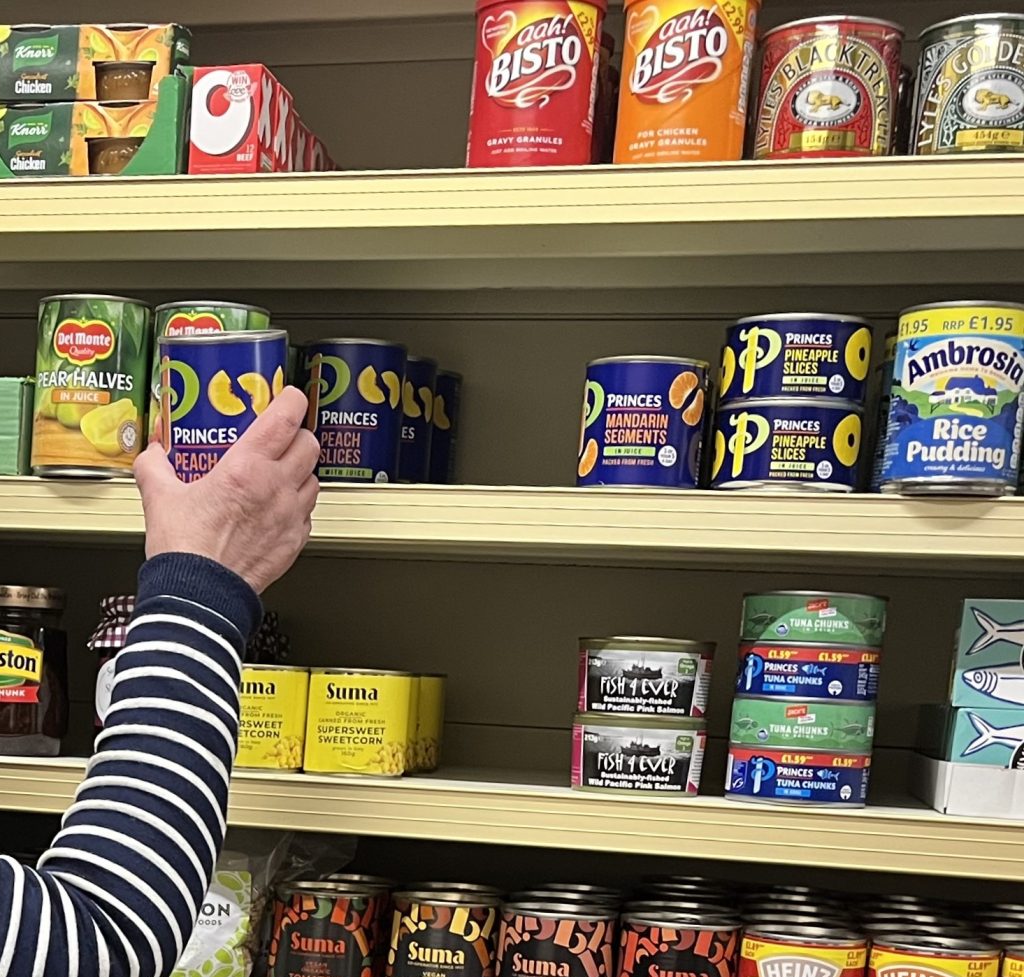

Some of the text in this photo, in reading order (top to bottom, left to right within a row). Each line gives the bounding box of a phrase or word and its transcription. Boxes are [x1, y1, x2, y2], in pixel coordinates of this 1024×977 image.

[517, 14, 574, 46] aah!
[488, 35, 582, 96] BISTO
[15, 80, 52, 94] Chicken
[486, 135, 563, 146] GRAVY GRANULES
[637, 128, 699, 139] FOR CHICKEN
[942, 320, 965, 331] RRP
[969, 316, 1013, 331] £1.95
[58, 332, 111, 347] Del Monte
[784, 348, 838, 363] PINEAPPLE
[908, 340, 1024, 386] Ambrosia
[783, 362, 818, 375] SLICES
[37, 369, 133, 392] PEAR HALVES
[60, 392, 100, 402] IN JUICE
[606, 393, 662, 408] PRINCES
[321, 410, 378, 426] PRINCES
[606, 413, 669, 430] MANDARIN
[173, 427, 238, 444] PRINCES
[933, 417, 987, 441] Rice
[604, 429, 667, 445] SEGMENTS
[175, 452, 218, 471] PEACH
[319, 448, 361, 465] SLICES
[906, 440, 1005, 469] Pudding
[789, 618, 849, 630] TUNA CHUNKS
[629, 677, 637, 695] 4
[641, 677, 679, 698] EVER
[763, 674, 823, 686] TUNA CHUNKS
[591, 703, 685, 714] Wild Pacific Pink Salmon
[317, 725, 386, 735] SUPERSWEET
[318, 735, 383, 745] SWEETCORN
[408, 941, 465, 965] Suma
